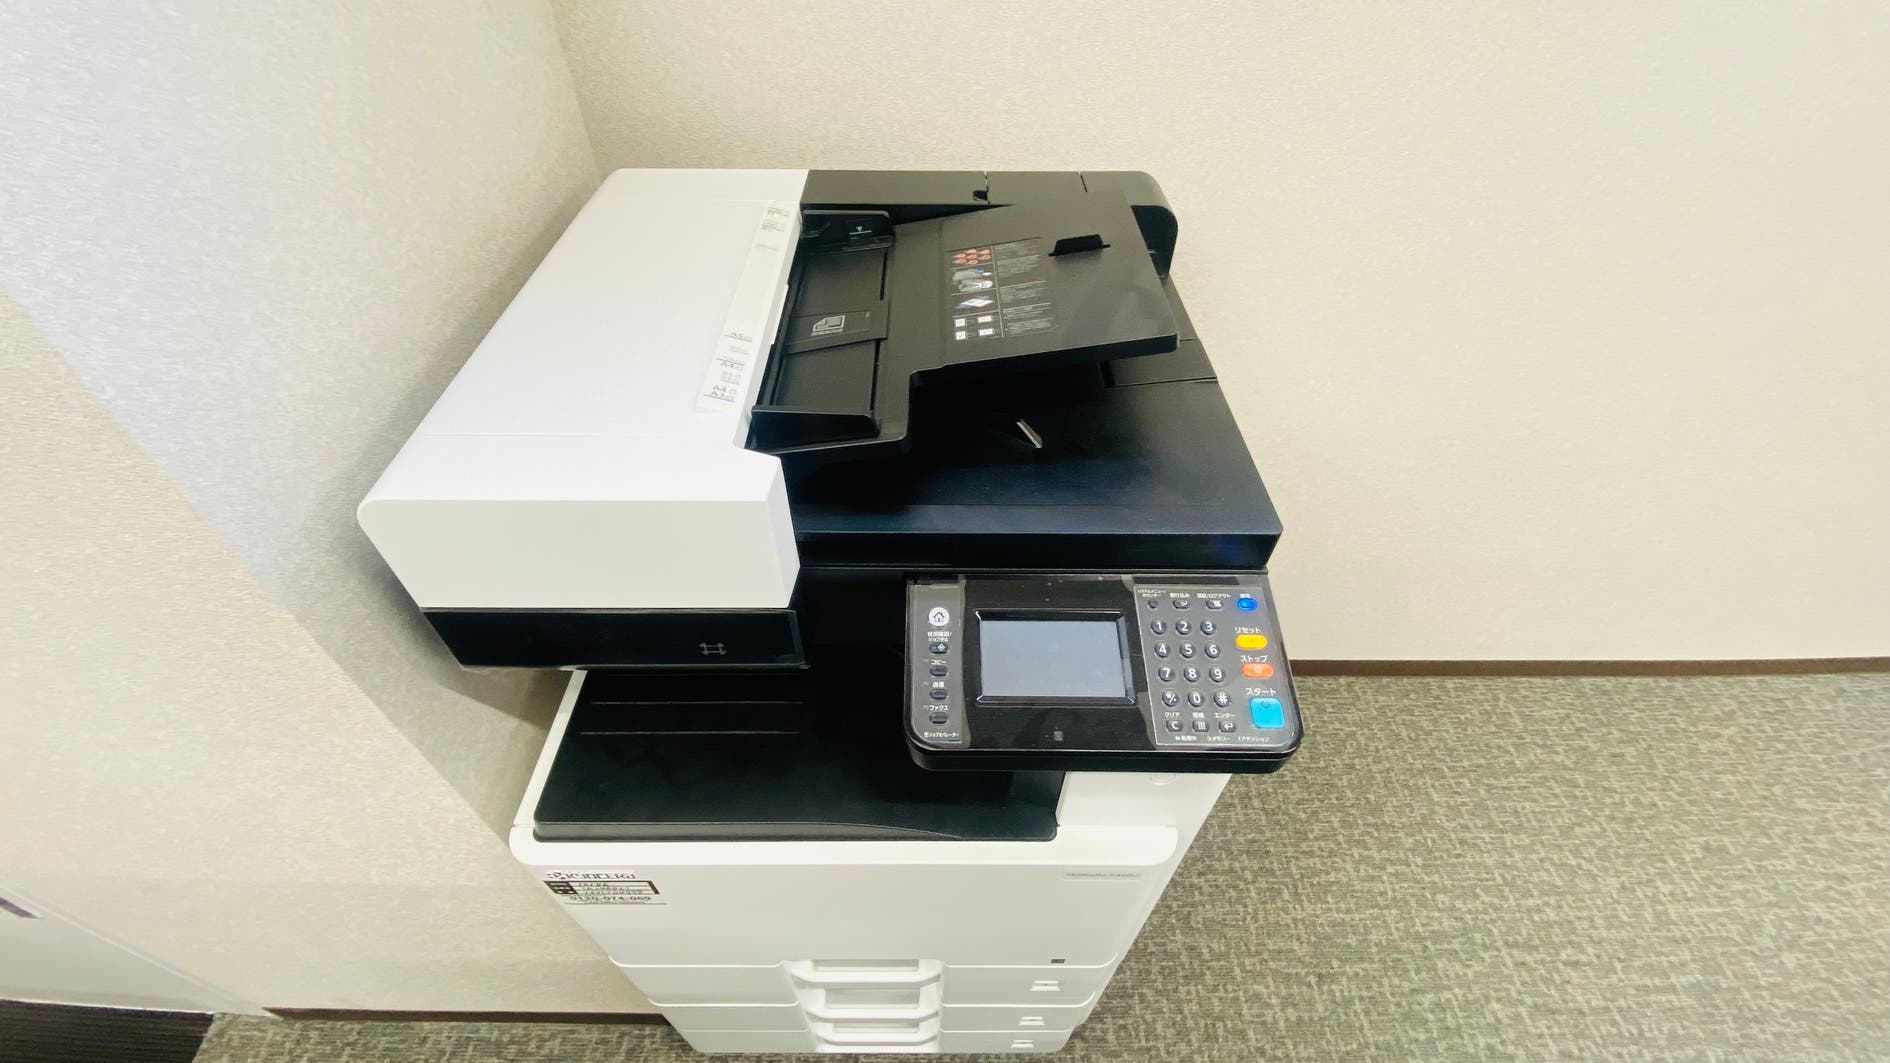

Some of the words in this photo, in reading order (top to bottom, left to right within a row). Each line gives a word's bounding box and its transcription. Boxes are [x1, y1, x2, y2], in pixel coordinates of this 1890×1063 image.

[1156, 621, 1162, 631] 1
[1181, 621, 1189, 631] 2
[1205, 622, 1213, 631] 3
[1159, 645, 1167, 654] 4
[1184, 645, 1193, 654] 5
[1209, 645, 1218, 655] 6
[1240, 655, 1268, 663] ストップ
[1163, 668, 1171, 678] 7
[1188, 668, 1197, 678] 8
[1214, 669, 1222, 679] 9
[1245, 688, 1277, 696] スタート
[1192, 694, 1201, 703] 0
[1171, 722, 1178, 730] C
